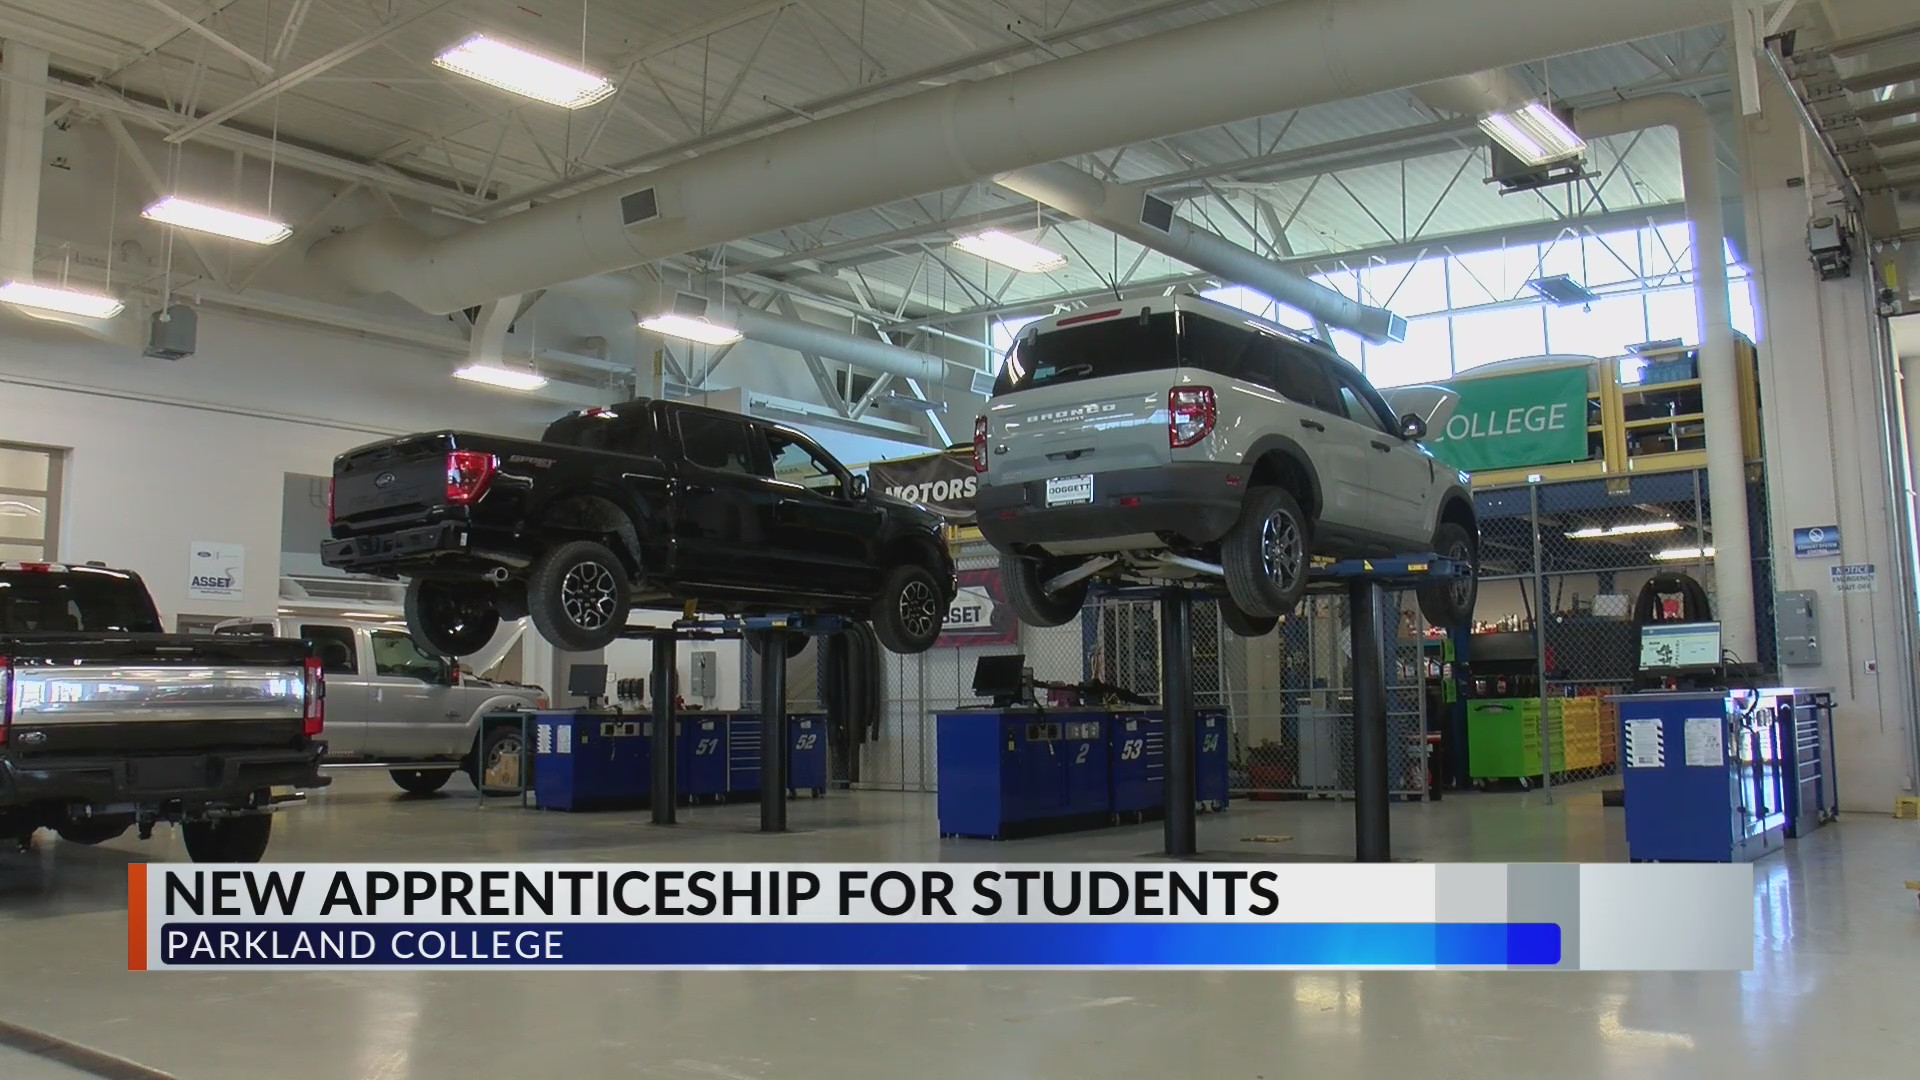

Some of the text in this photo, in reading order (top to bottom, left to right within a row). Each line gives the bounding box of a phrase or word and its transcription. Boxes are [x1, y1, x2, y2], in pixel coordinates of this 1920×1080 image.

[1027, 404, 1116, 422] BRONCO
[1435, 403, 1567, 442] OLLEGE
[886, 476, 977, 503] MOTORS
[1049, 483, 1091, 494] DOGGETT
[1836, 565, 1869, 574] NOTICE
[191, 576, 231, 588] ASSET
[1832, 575, 1875, 583] EMERGENCY
[695, 738, 719, 755] 51
[795, 734, 817, 750] 52
[1121, 739, 1143, 760] 53
[1202, 733, 1219, 752] 54
[1075, 743, 1090, 764] 2
